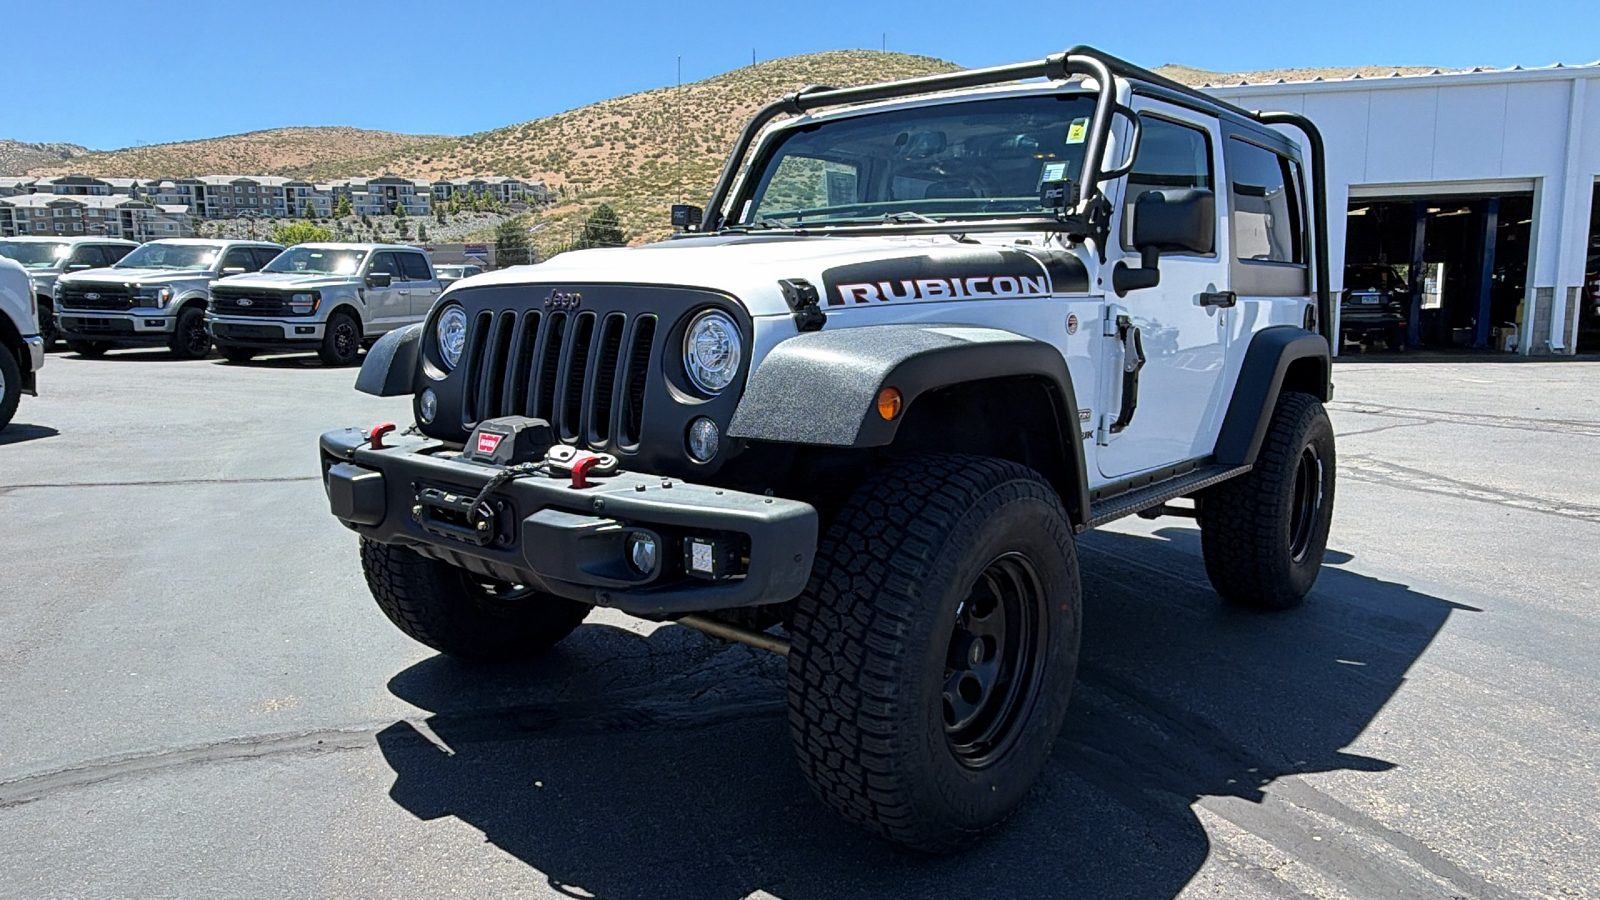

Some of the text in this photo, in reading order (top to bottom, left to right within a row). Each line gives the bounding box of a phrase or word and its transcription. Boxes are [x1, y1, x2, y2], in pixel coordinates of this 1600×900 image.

[1045, 188, 1064, 198] RC
[544, 288, 582, 310] Jeep
[835, 276, 1046, 306] RUBICON
